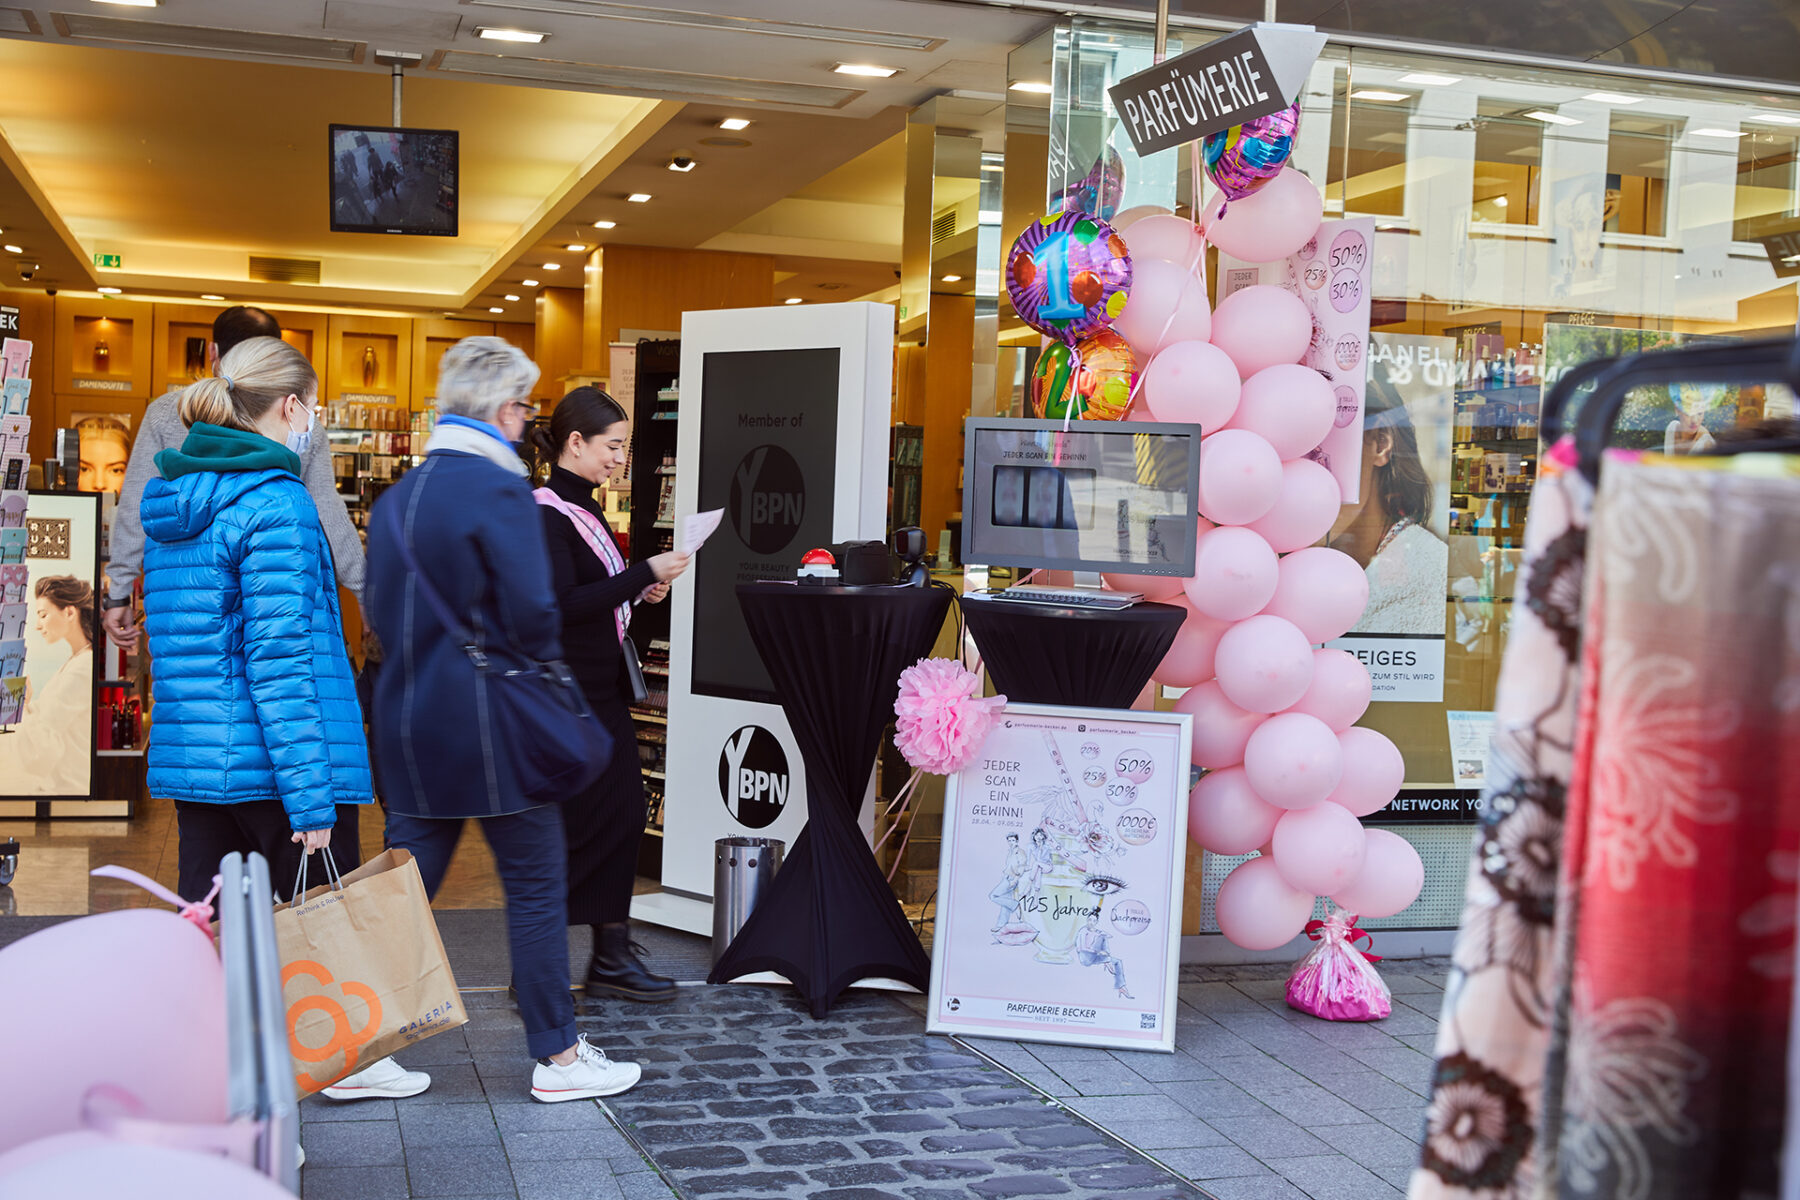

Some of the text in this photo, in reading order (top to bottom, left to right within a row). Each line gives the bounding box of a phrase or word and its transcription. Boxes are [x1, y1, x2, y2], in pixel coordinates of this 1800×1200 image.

[1124, 50, 1269, 145] PARFÜMERIE
[1331, 243, 1363, 268] 50%
[1034, 231, 1087, 319] 1
[1305, 268, 1327, 281] 25%
[1332, 279, 1359, 299] 30%
[738, 413, 804, 428] Member of
[1003, 451, 1022, 460] JEDER
[1025, 452, 1043, 460] SCAN
[736, 446, 803, 546] YBPN
[760, 563, 790, 572] BEAUTY
[1393, 673, 1410, 681] STIL
[1080, 746, 1100, 755] 20%
[724, 726, 788, 820] YBPN
[983, 759, 1021, 772] JEDER
[1116, 758, 1152, 775] 50%
[985, 774, 1017, 787] SCAN
[1083, 771, 1106, 782] 25%
[990, 790, 1010, 801] EIN
[1106, 784, 1136, 799] 30%
[972, 804, 1023, 819] GEWINN!
[1391, 798, 1460, 811] NETWORK
[1117, 815, 1156, 829] 1000€
[1019, 895, 1091, 920] 125 Jahre
[399, 1001, 452, 1034] GALERIA
[1006, 1003, 1096, 1018] PARFÜMERIE BECKER
